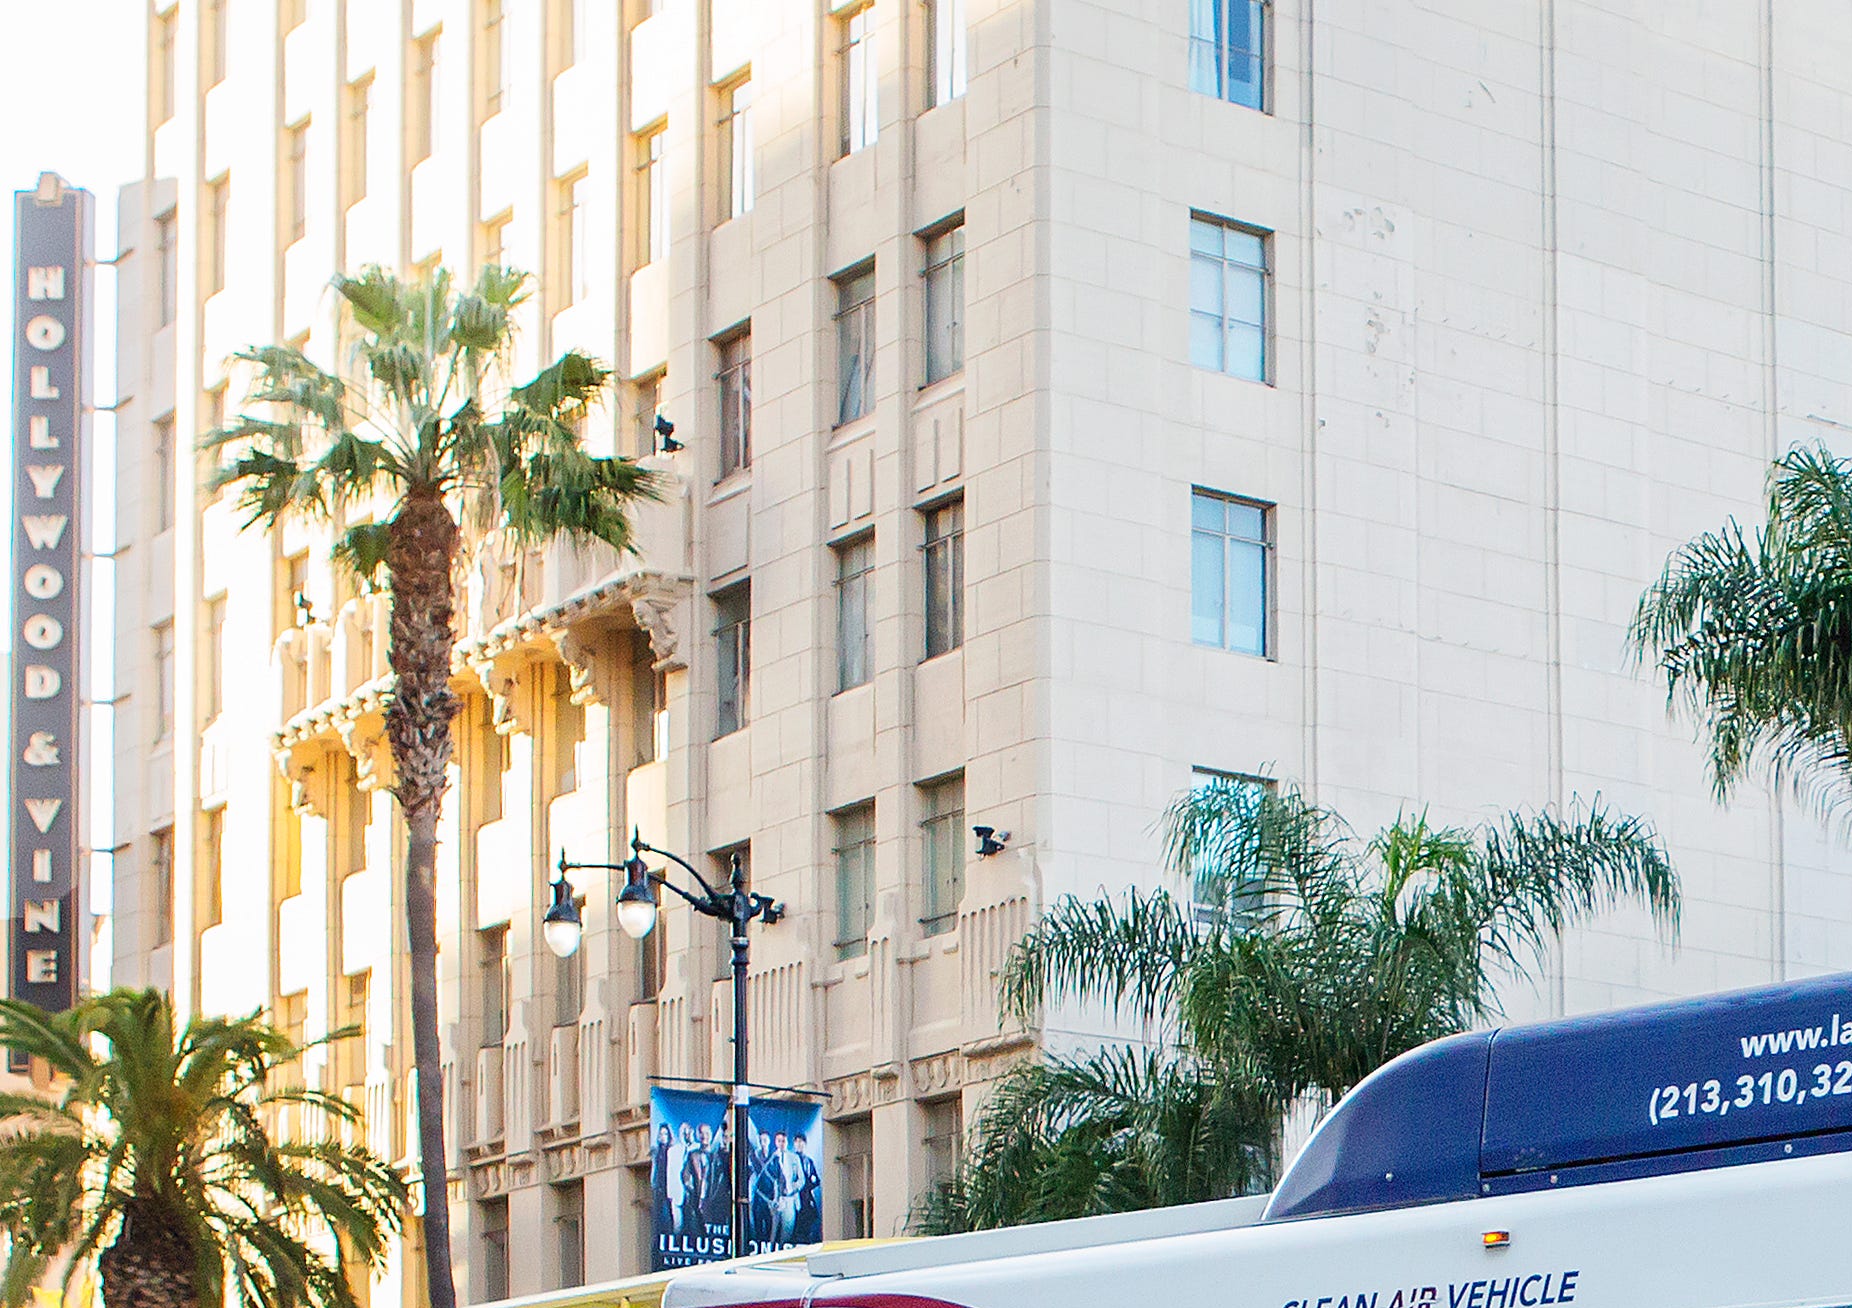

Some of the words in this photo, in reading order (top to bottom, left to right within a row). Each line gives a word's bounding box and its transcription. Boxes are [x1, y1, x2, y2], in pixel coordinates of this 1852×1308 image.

[22, 264, 69, 701] HOLLYWOOD
[22, 730, 63, 767] &
[22, 797, 64, 986] VINE
[704, 1223, 730, 1236] THE
